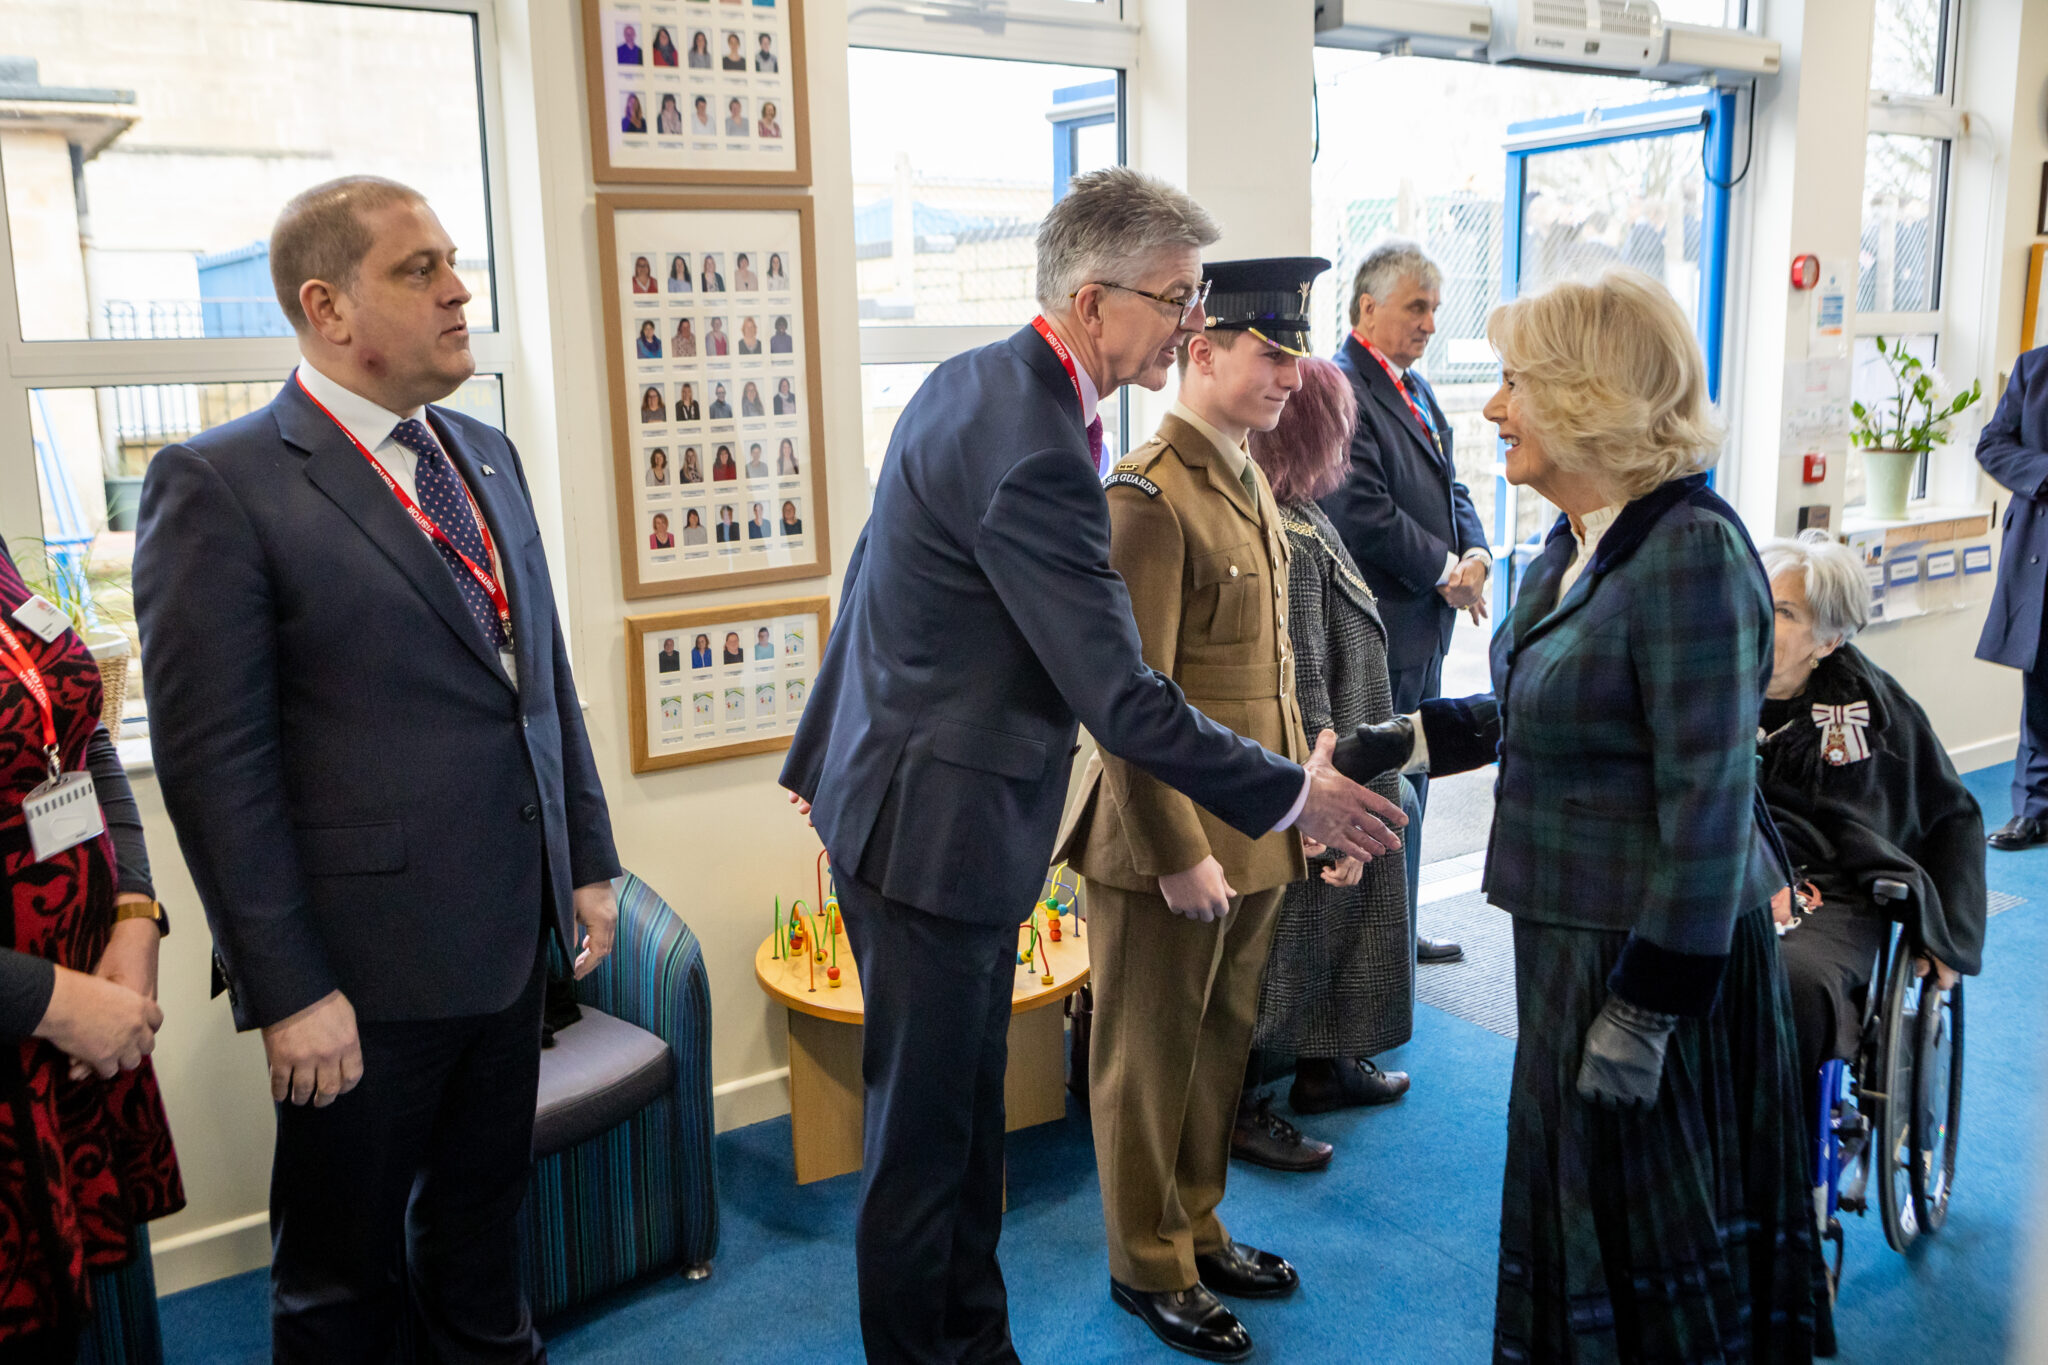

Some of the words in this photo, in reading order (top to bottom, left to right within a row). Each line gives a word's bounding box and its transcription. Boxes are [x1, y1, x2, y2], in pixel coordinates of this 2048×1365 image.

[1045, 331, 1069, 361] VISITOR
[1102, 474, 1119, 489] LSH
[1119, 473, 1158, 495] GUARDS
[406, 504, 435, 535] VISITOR
[473, 566, 497, 595] VISITOR
